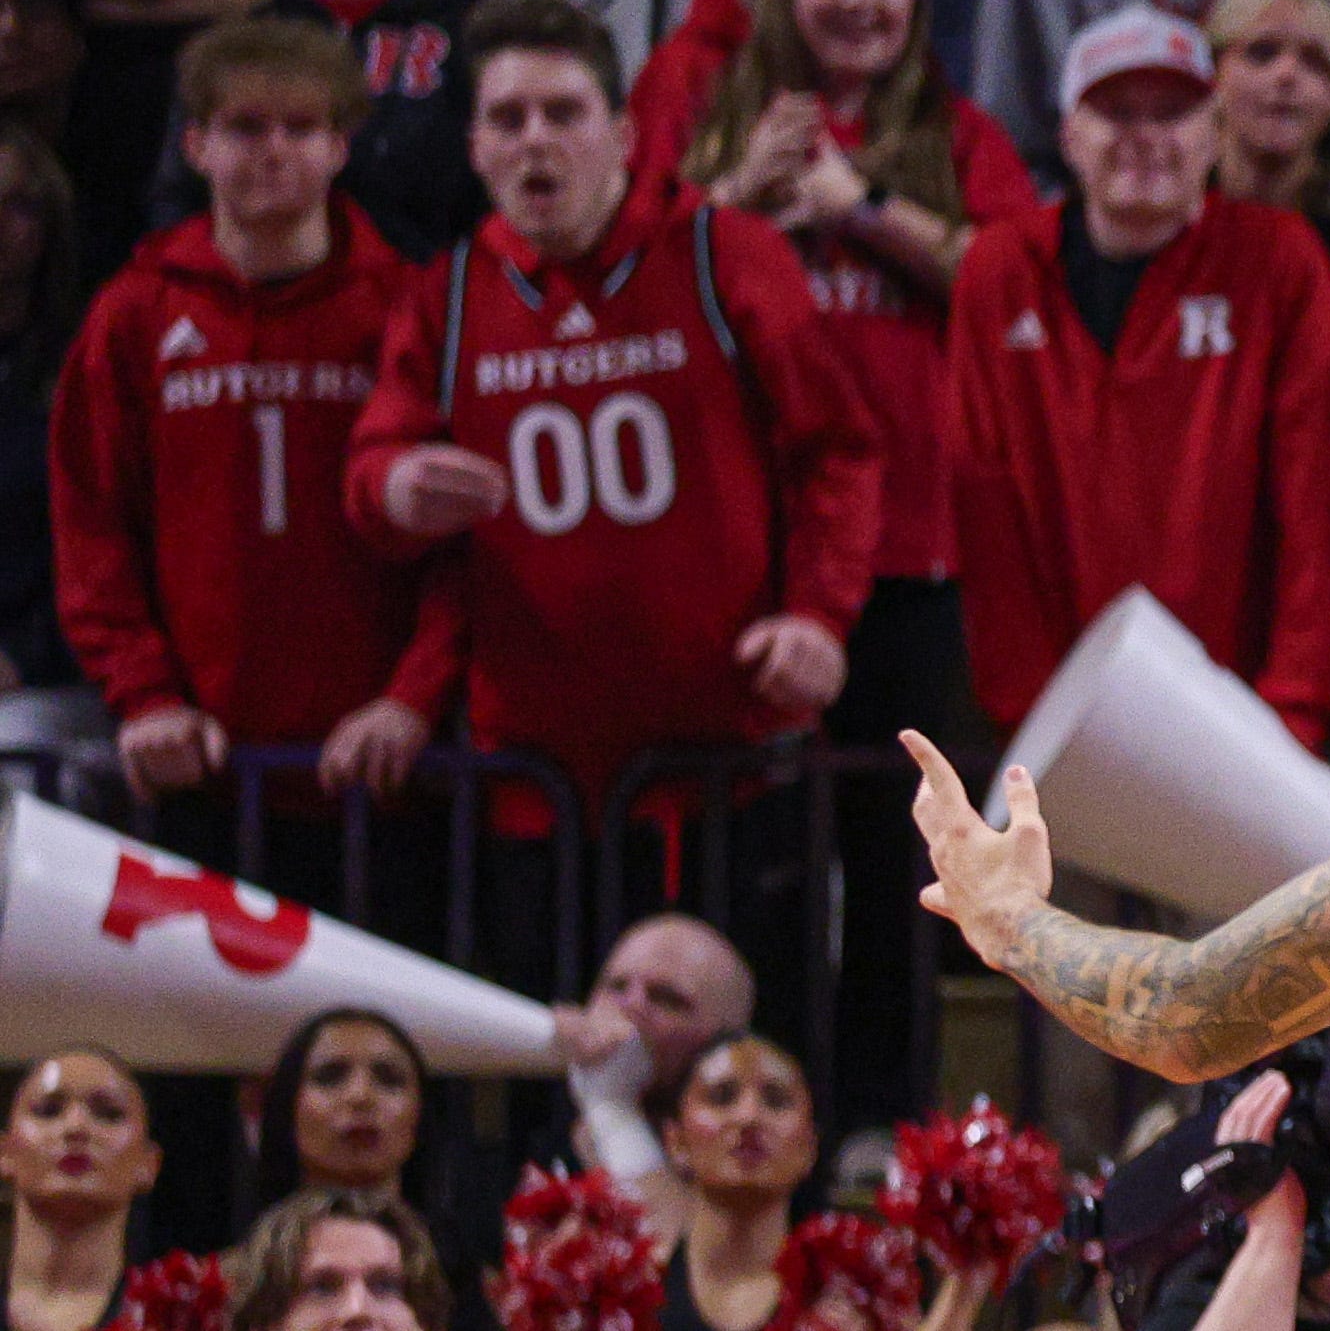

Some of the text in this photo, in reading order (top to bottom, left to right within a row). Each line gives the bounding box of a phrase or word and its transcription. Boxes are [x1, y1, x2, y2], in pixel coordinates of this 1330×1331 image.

[475, 328, 688, 397] RUTGERS
[1179, 292, 1237, 359] R
[253, 403, 288, 534] 1
[509, 392, 677, 536] 00
